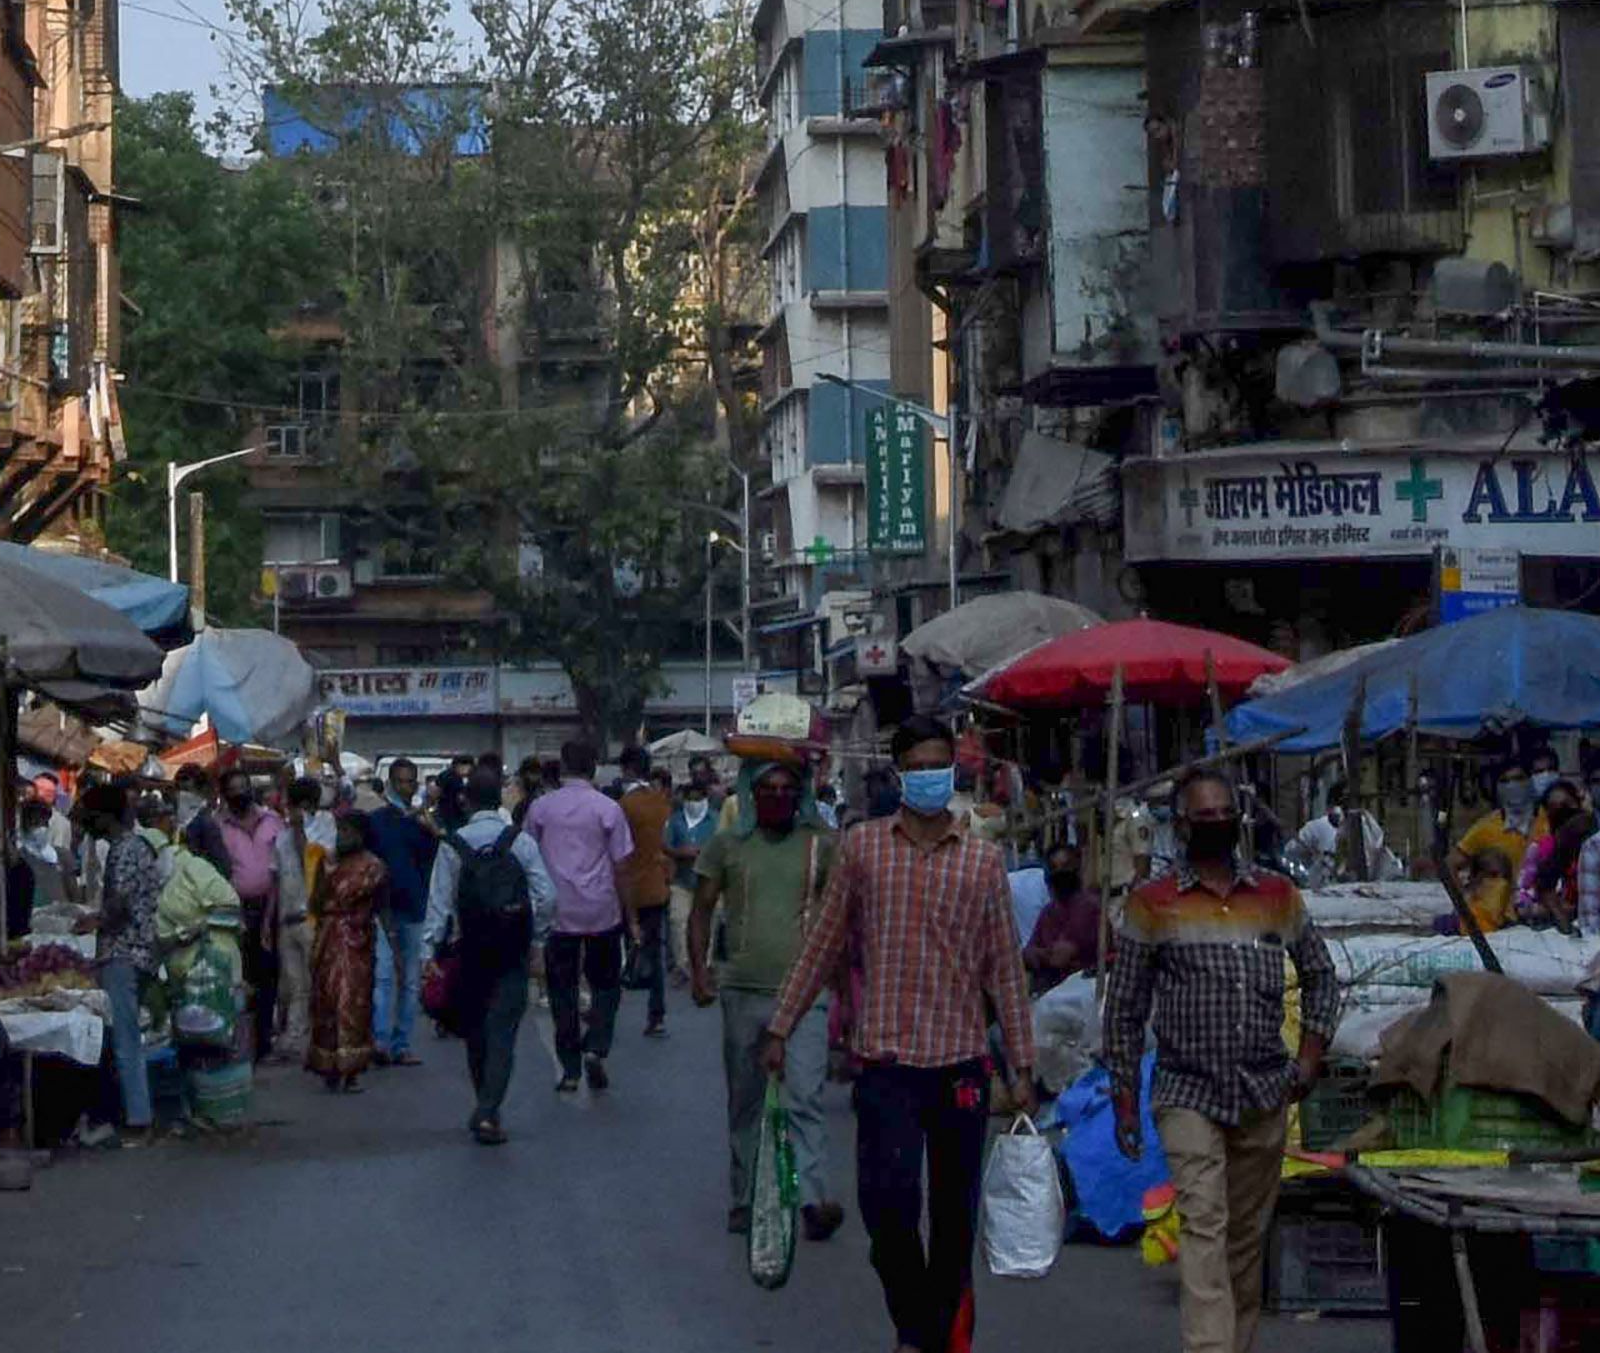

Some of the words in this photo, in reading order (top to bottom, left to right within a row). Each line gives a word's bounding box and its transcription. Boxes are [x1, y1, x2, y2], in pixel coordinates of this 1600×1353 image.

[896, 415, 917, 536] Mariyam
[1204, 475, 1269, 520] आलम
[1273, 460, 1382, 518] मेडिकल
